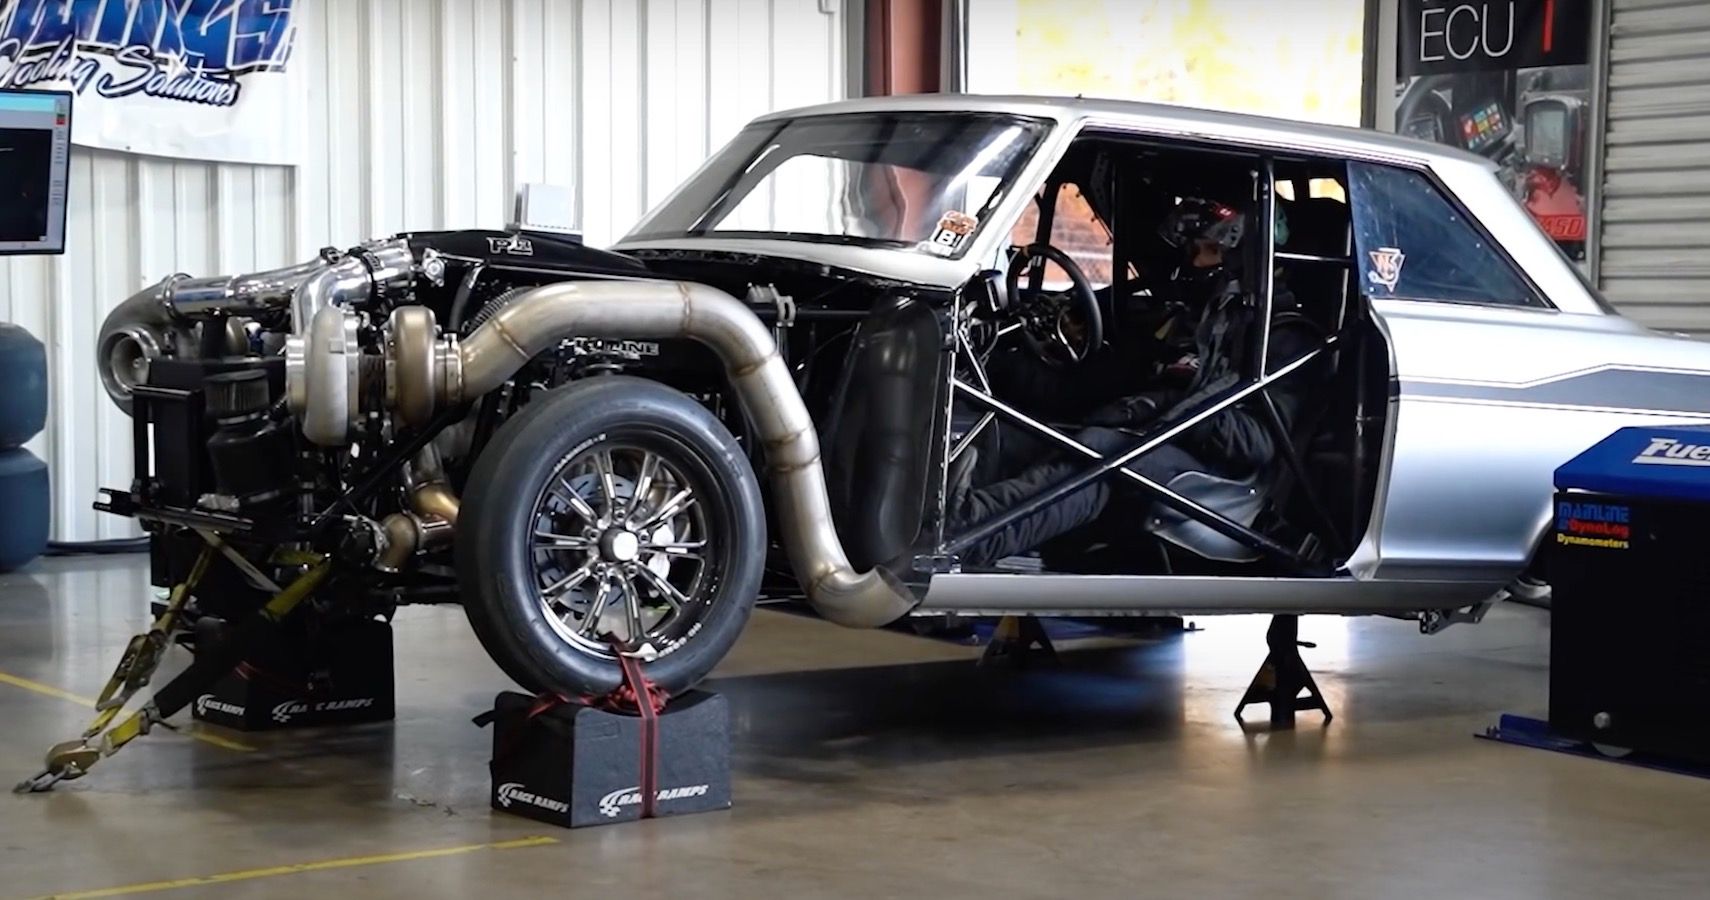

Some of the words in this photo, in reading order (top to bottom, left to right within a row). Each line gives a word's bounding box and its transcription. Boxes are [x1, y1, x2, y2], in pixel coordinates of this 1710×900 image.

[1420, 2, 1514, 62] ECU
[97, 45, 241, 106] Solutions
[1641, 437, 1710, 460] Fue
[1557, 533, 1629, 549] Dynamometers
[289, 702, 324, 713] RAE
[326, 698, 374, 710] RAMPS
[508, 789, 535, 803] RACE
[533, 796, 569, 813] RAMPS
[656, 785, 709, 801] RAMPS
